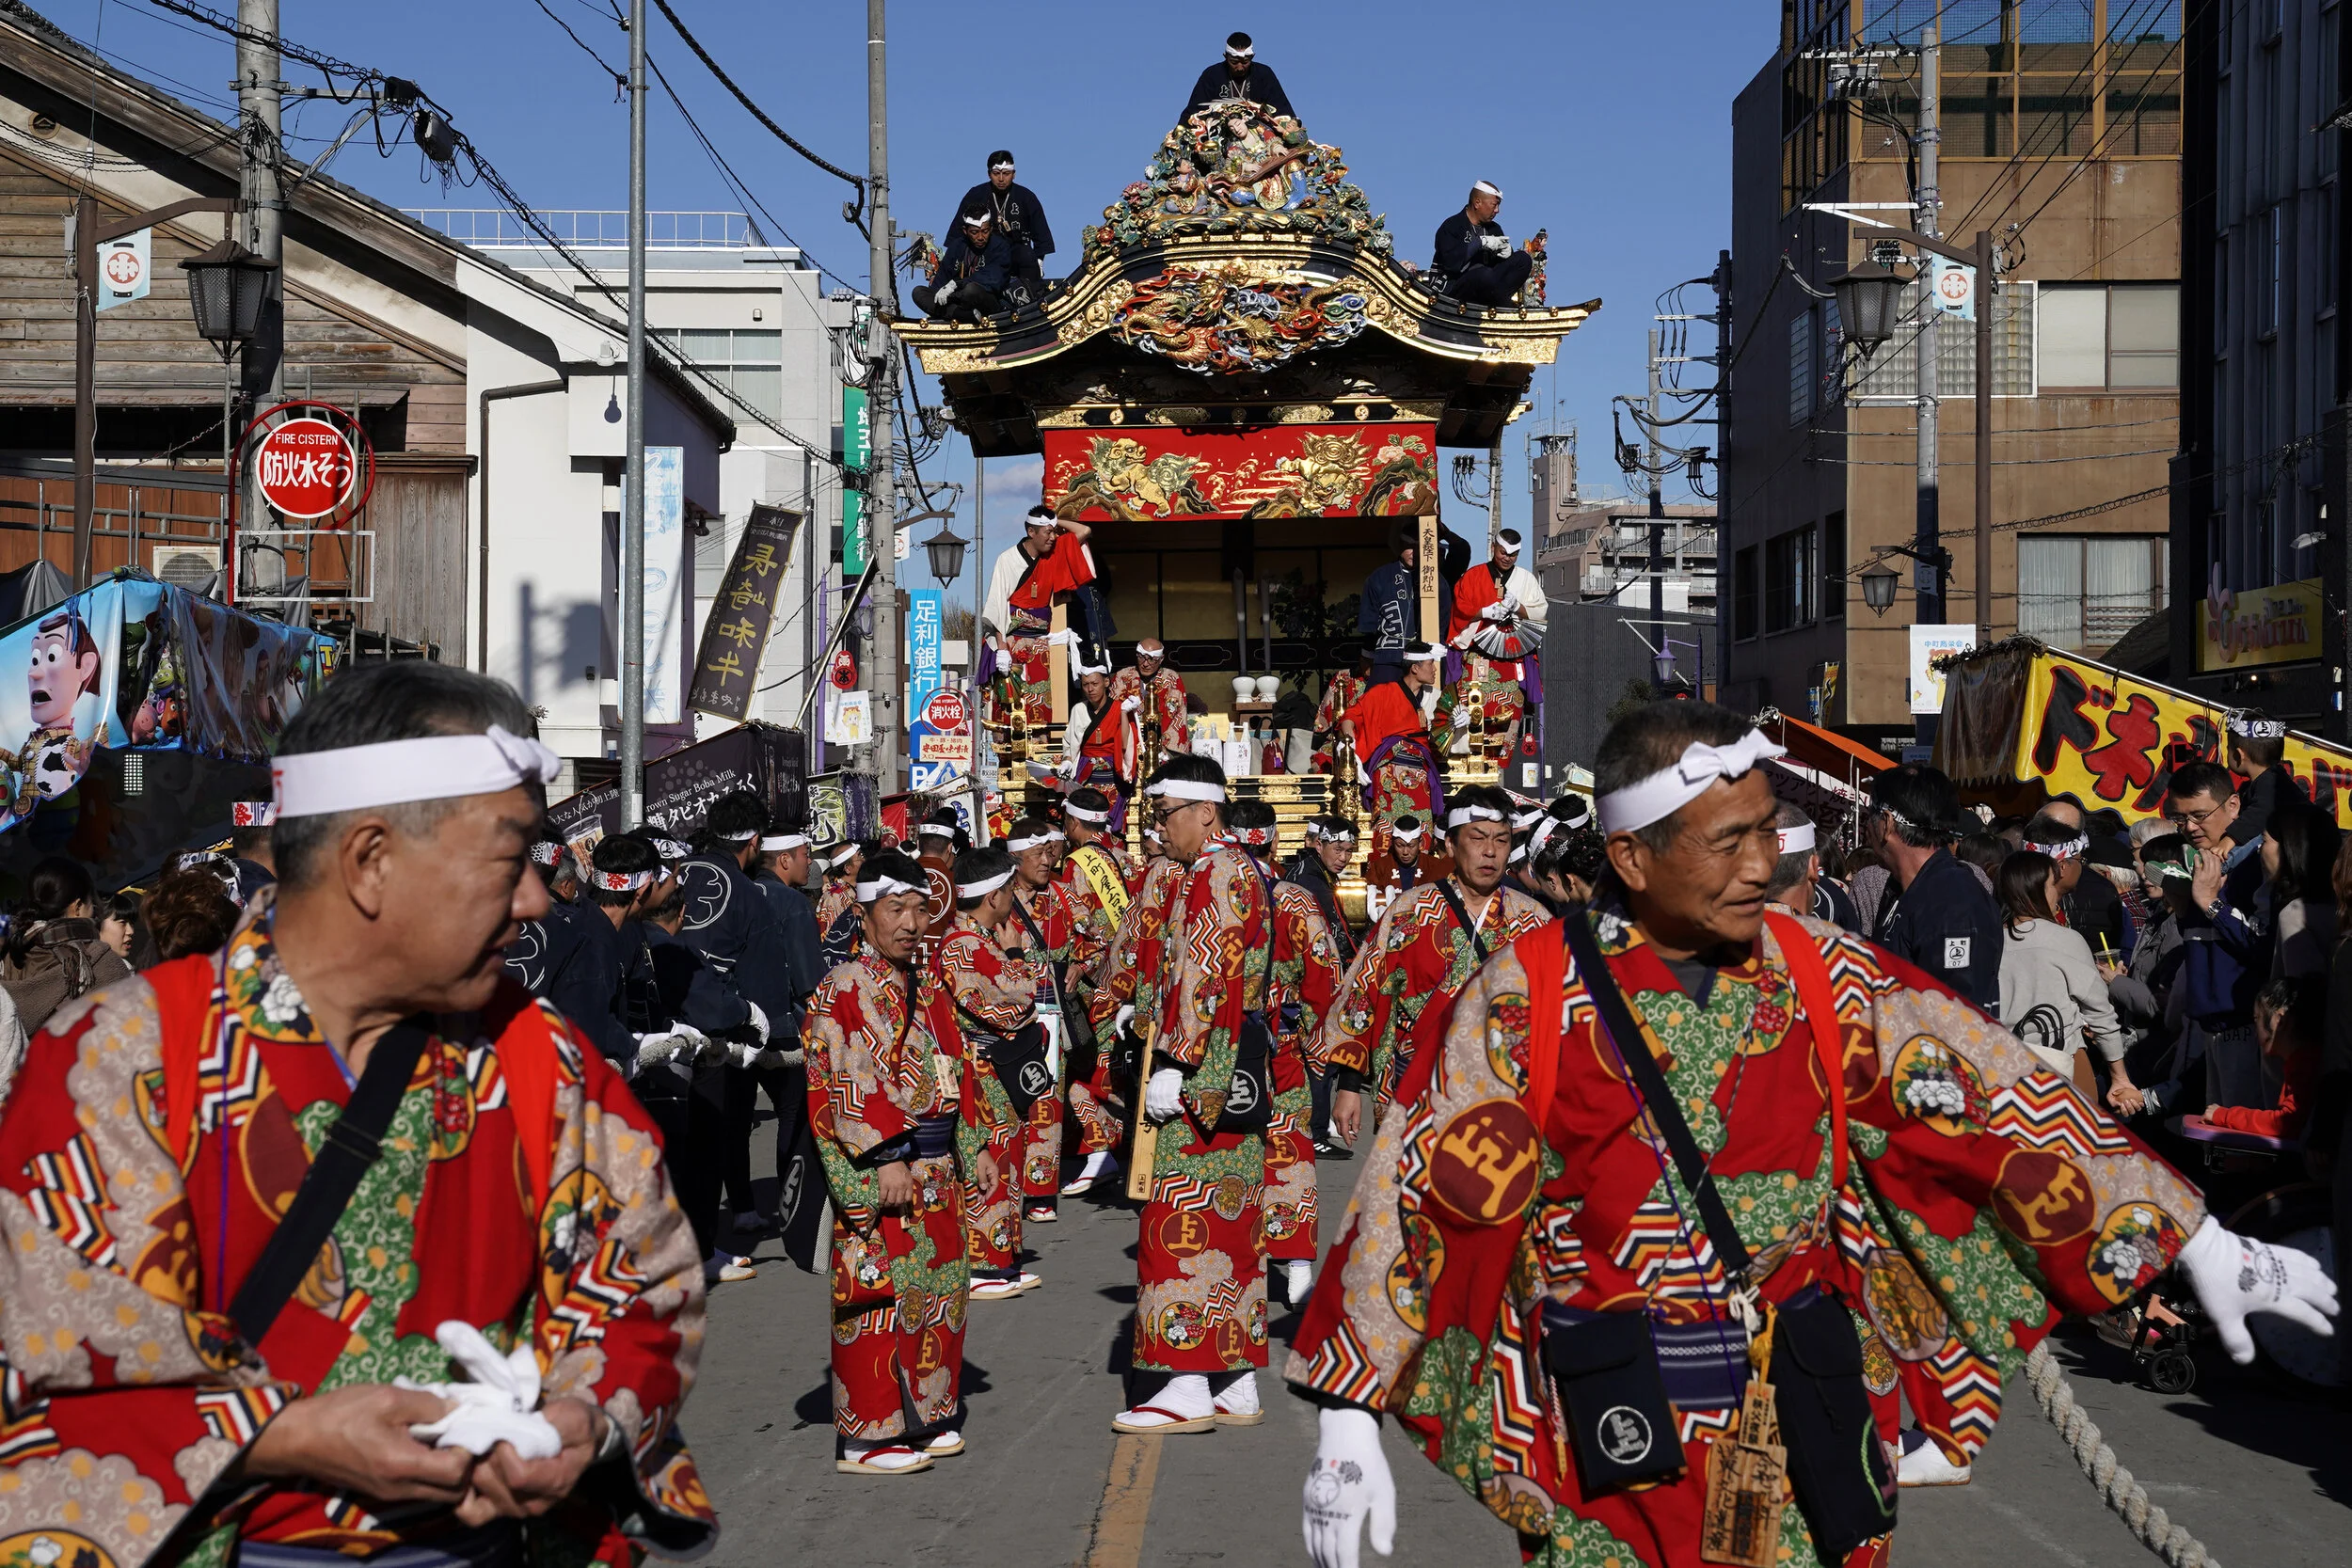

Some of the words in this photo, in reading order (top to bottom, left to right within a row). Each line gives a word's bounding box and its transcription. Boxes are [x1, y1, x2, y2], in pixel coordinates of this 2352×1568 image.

[276, 434, 296, 445] FIRE
[298, 434, 339, 446] CISTERN
[263, 451, 352, 487] 防火水そう
[1422, 528, 1435, 562] 天皇陛下
[1422, 564, 1435, 593] 御即位
[914, 599, 938, 693] 足利銀行
[930, 705, 961, 720] 消火栓
[646, 799, 668, 813] rown
[668, 788, 692, 802] Sugar
[692, 780, 716, 793] Boba
[715, 768, 736, 784] Milk
